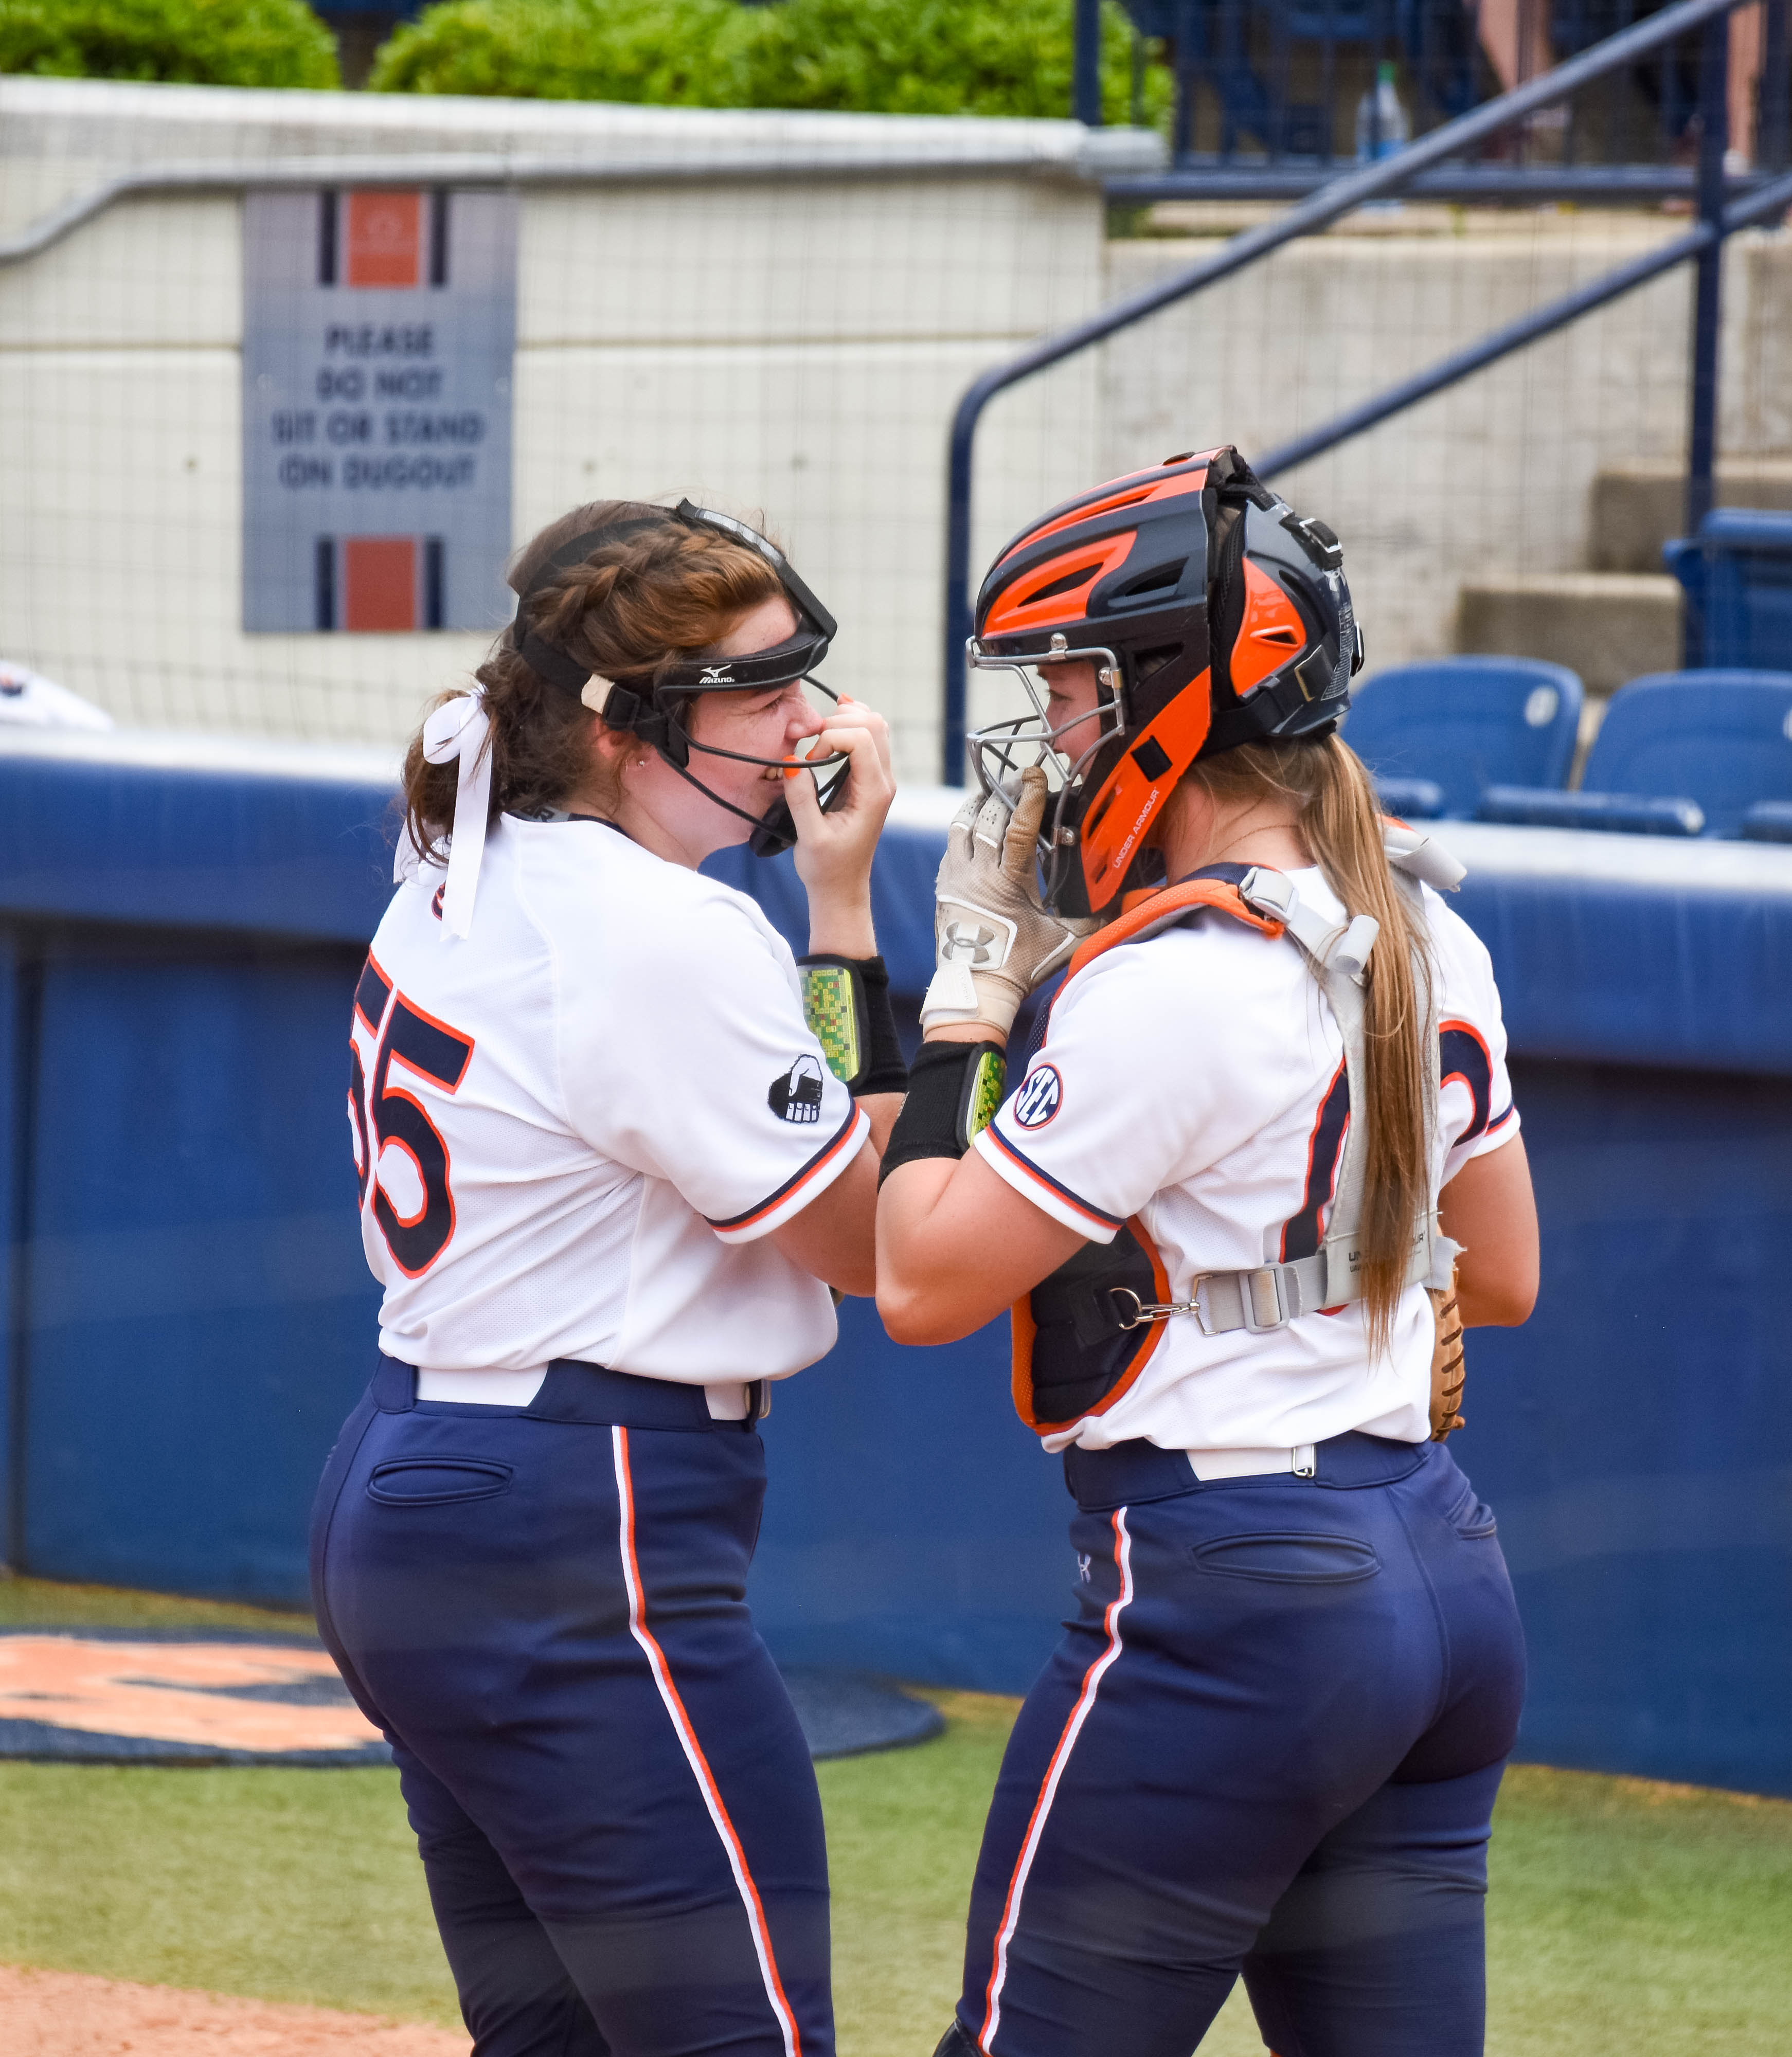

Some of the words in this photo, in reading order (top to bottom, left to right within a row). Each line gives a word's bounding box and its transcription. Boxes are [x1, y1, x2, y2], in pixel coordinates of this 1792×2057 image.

[325, 322, 434, 357] PLEASE
[317, 367, 364, 401] DO
[375, 367, 442, 401] NOT
[273, 411, 315, 445] SIT
[327, 412, 370, 446] OR
[384, 413, 485, 447] STAND
[279, 455, 333, 489] ON
[343, 456, 474, 490] DUGOUT
[1114, 835, 1135, 868] UNDER
[1133, 789, 1159, 834] ARMOUR
[1016, 1068, 1059, 1125] SEC
